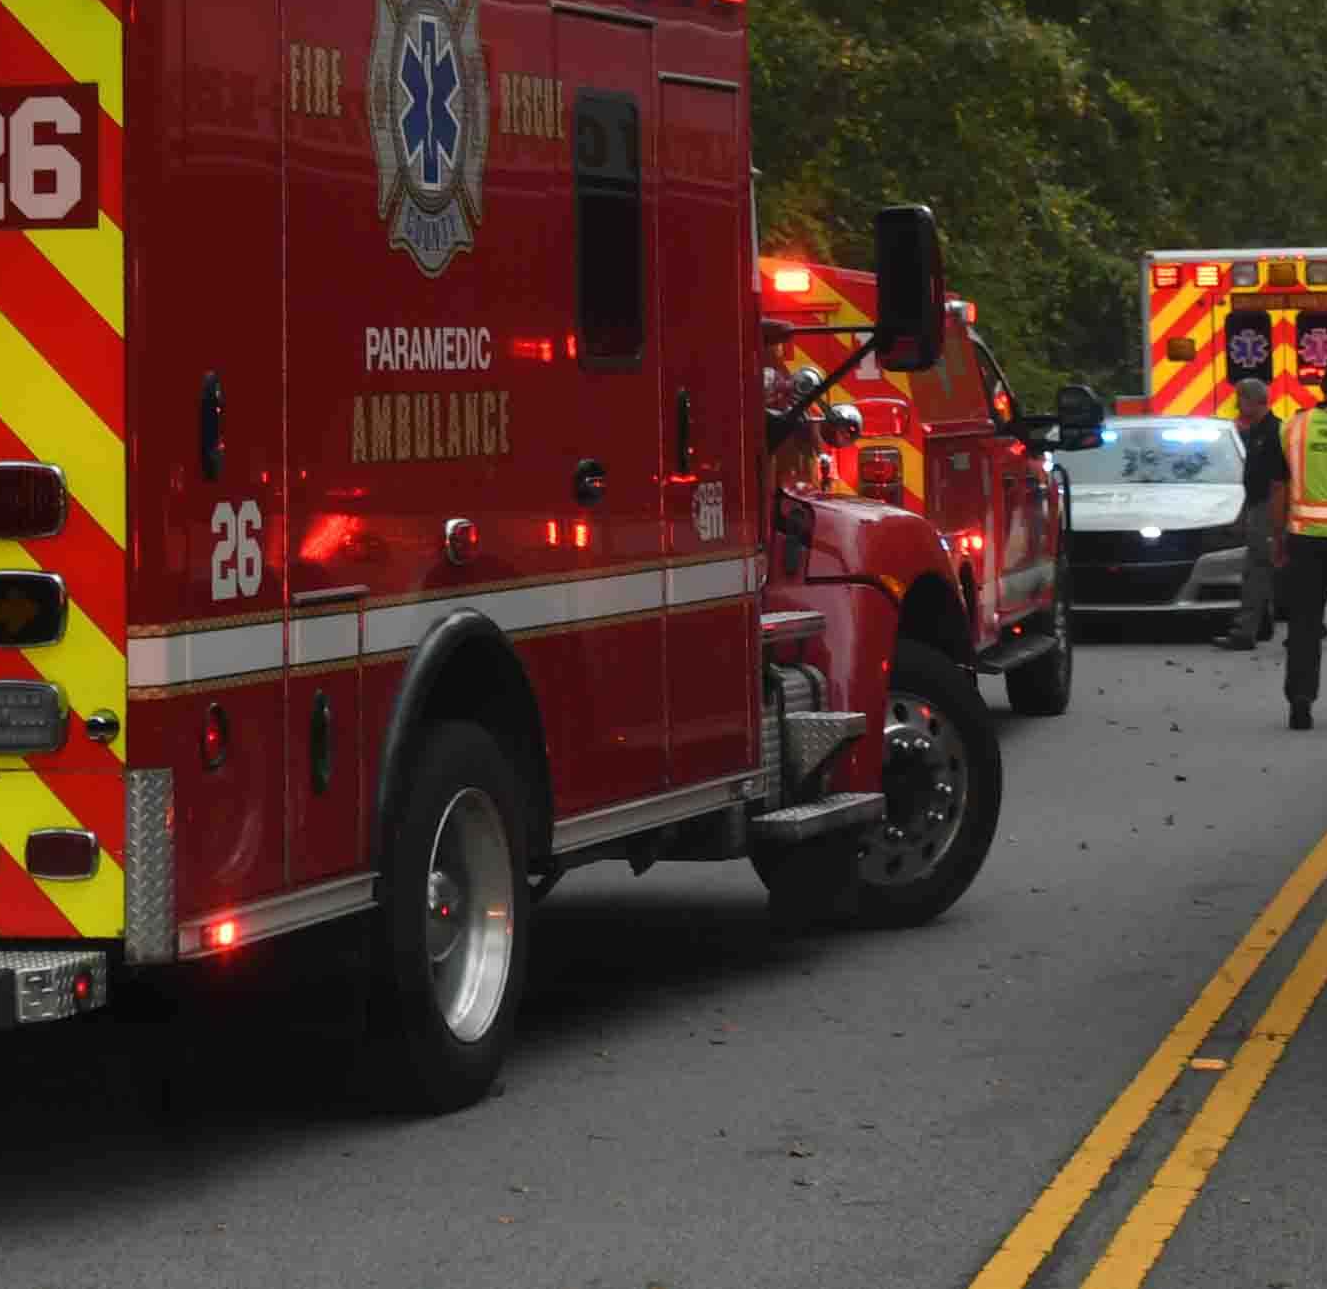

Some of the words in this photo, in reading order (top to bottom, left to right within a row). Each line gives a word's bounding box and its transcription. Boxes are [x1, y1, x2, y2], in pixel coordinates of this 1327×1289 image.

[288, 42, 343, 117] FIRE
[365, 326, 492, 372] PARAMEDIC
[352, 390, 510, 463] AMBULANCE
[211, 499, 262, 601] 26
